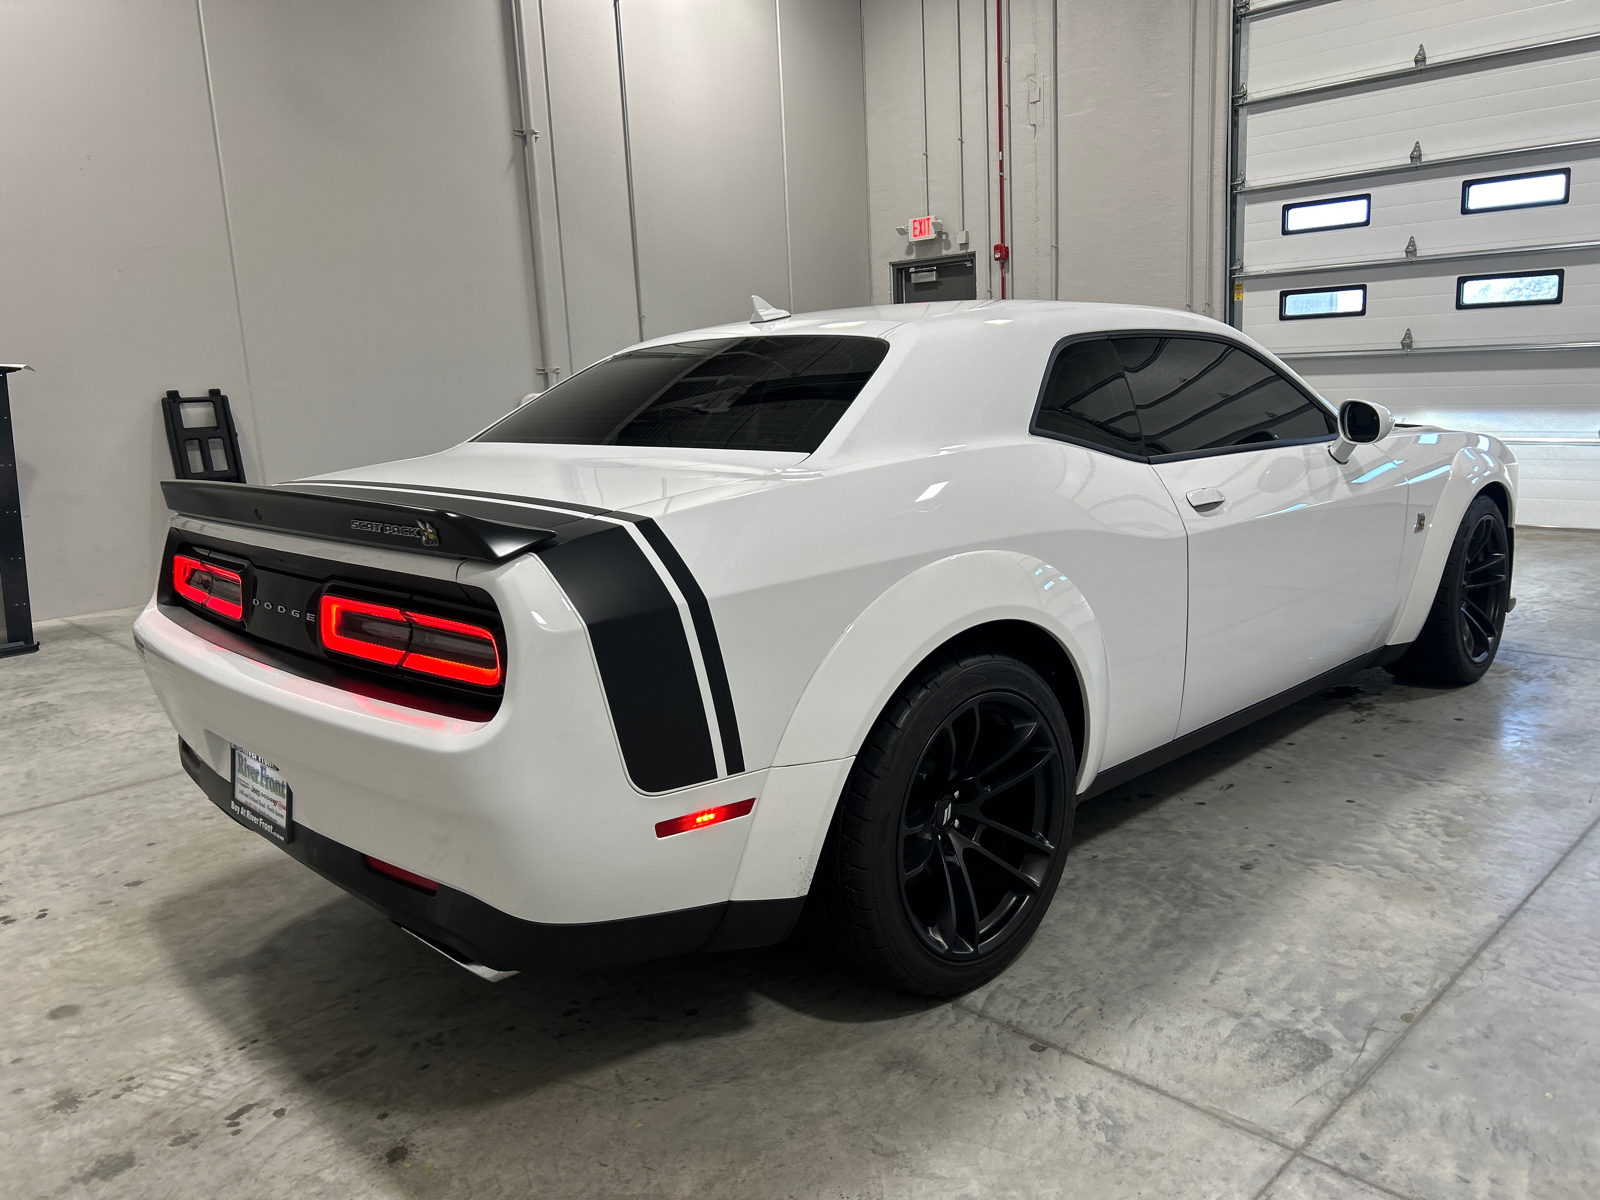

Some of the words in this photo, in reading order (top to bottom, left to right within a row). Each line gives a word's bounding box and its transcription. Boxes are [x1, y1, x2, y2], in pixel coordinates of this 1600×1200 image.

[912, 217, 931, 238] EXIT
[351, 519, 381, 533] SCAT
[383, 523, 421, 538] PACK
[252, 598, 316, 622] DODGE
[237, 752, 260, 784] River
[260, 765, 286, 799] Front
[230, 800, 240, 815] Buy
